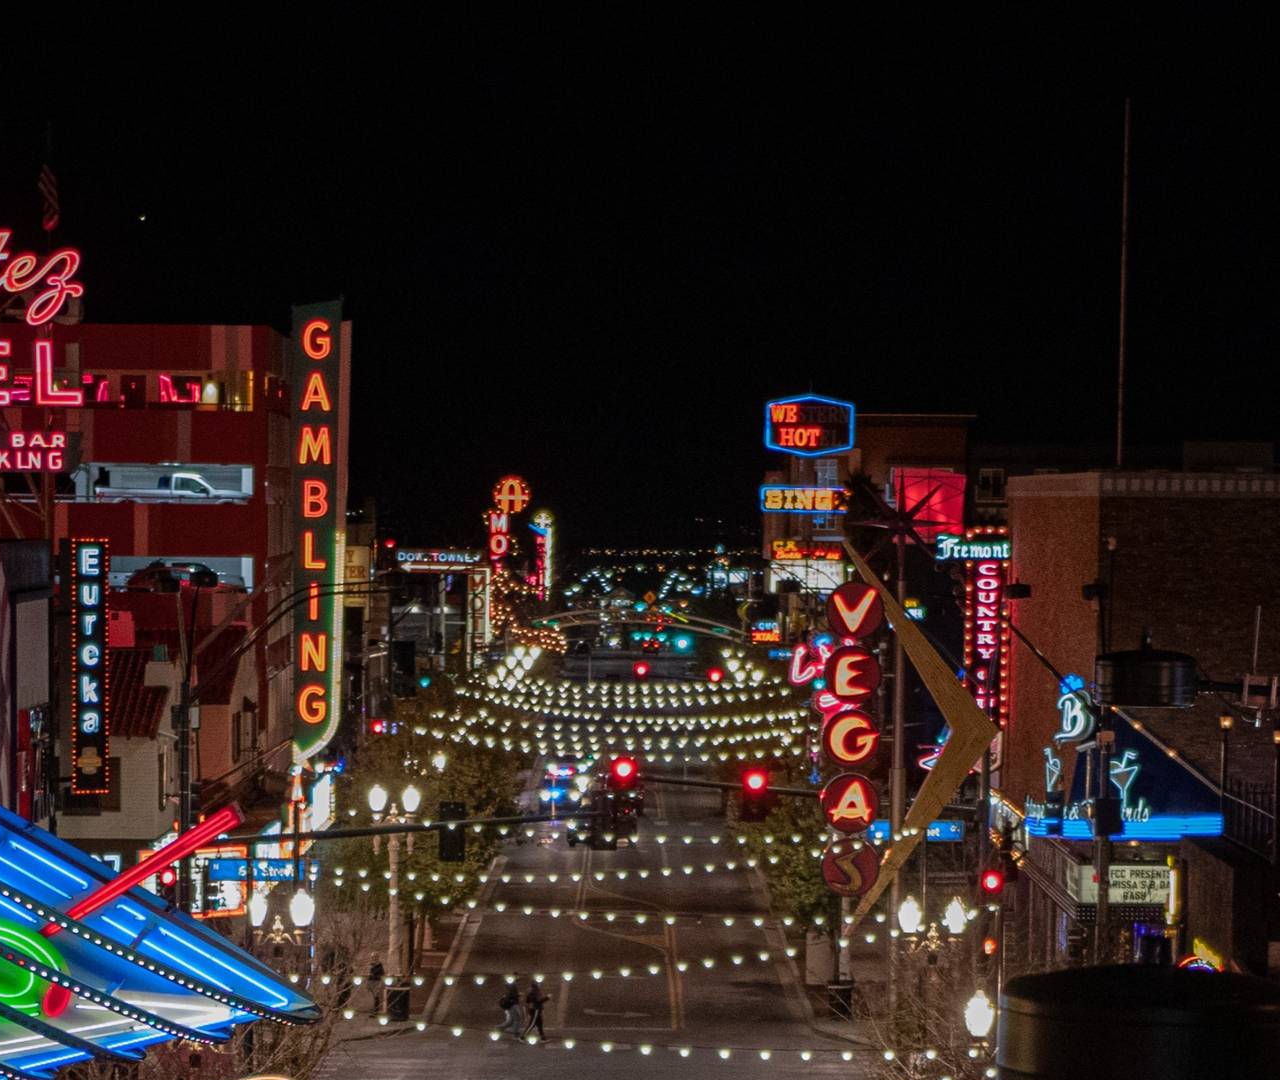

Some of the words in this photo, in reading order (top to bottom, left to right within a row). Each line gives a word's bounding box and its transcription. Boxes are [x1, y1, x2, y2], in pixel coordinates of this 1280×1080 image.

[11, 433, 66, 448] BAR
[298, 319, 332, 725] GAMBLING
[935, 535, 1010, 561] Fremont
[81, 548, 101, 734] Eureka
[975, 564, 999, 660] COUNTRY
[830, 587, 880, 892] VEGAS
